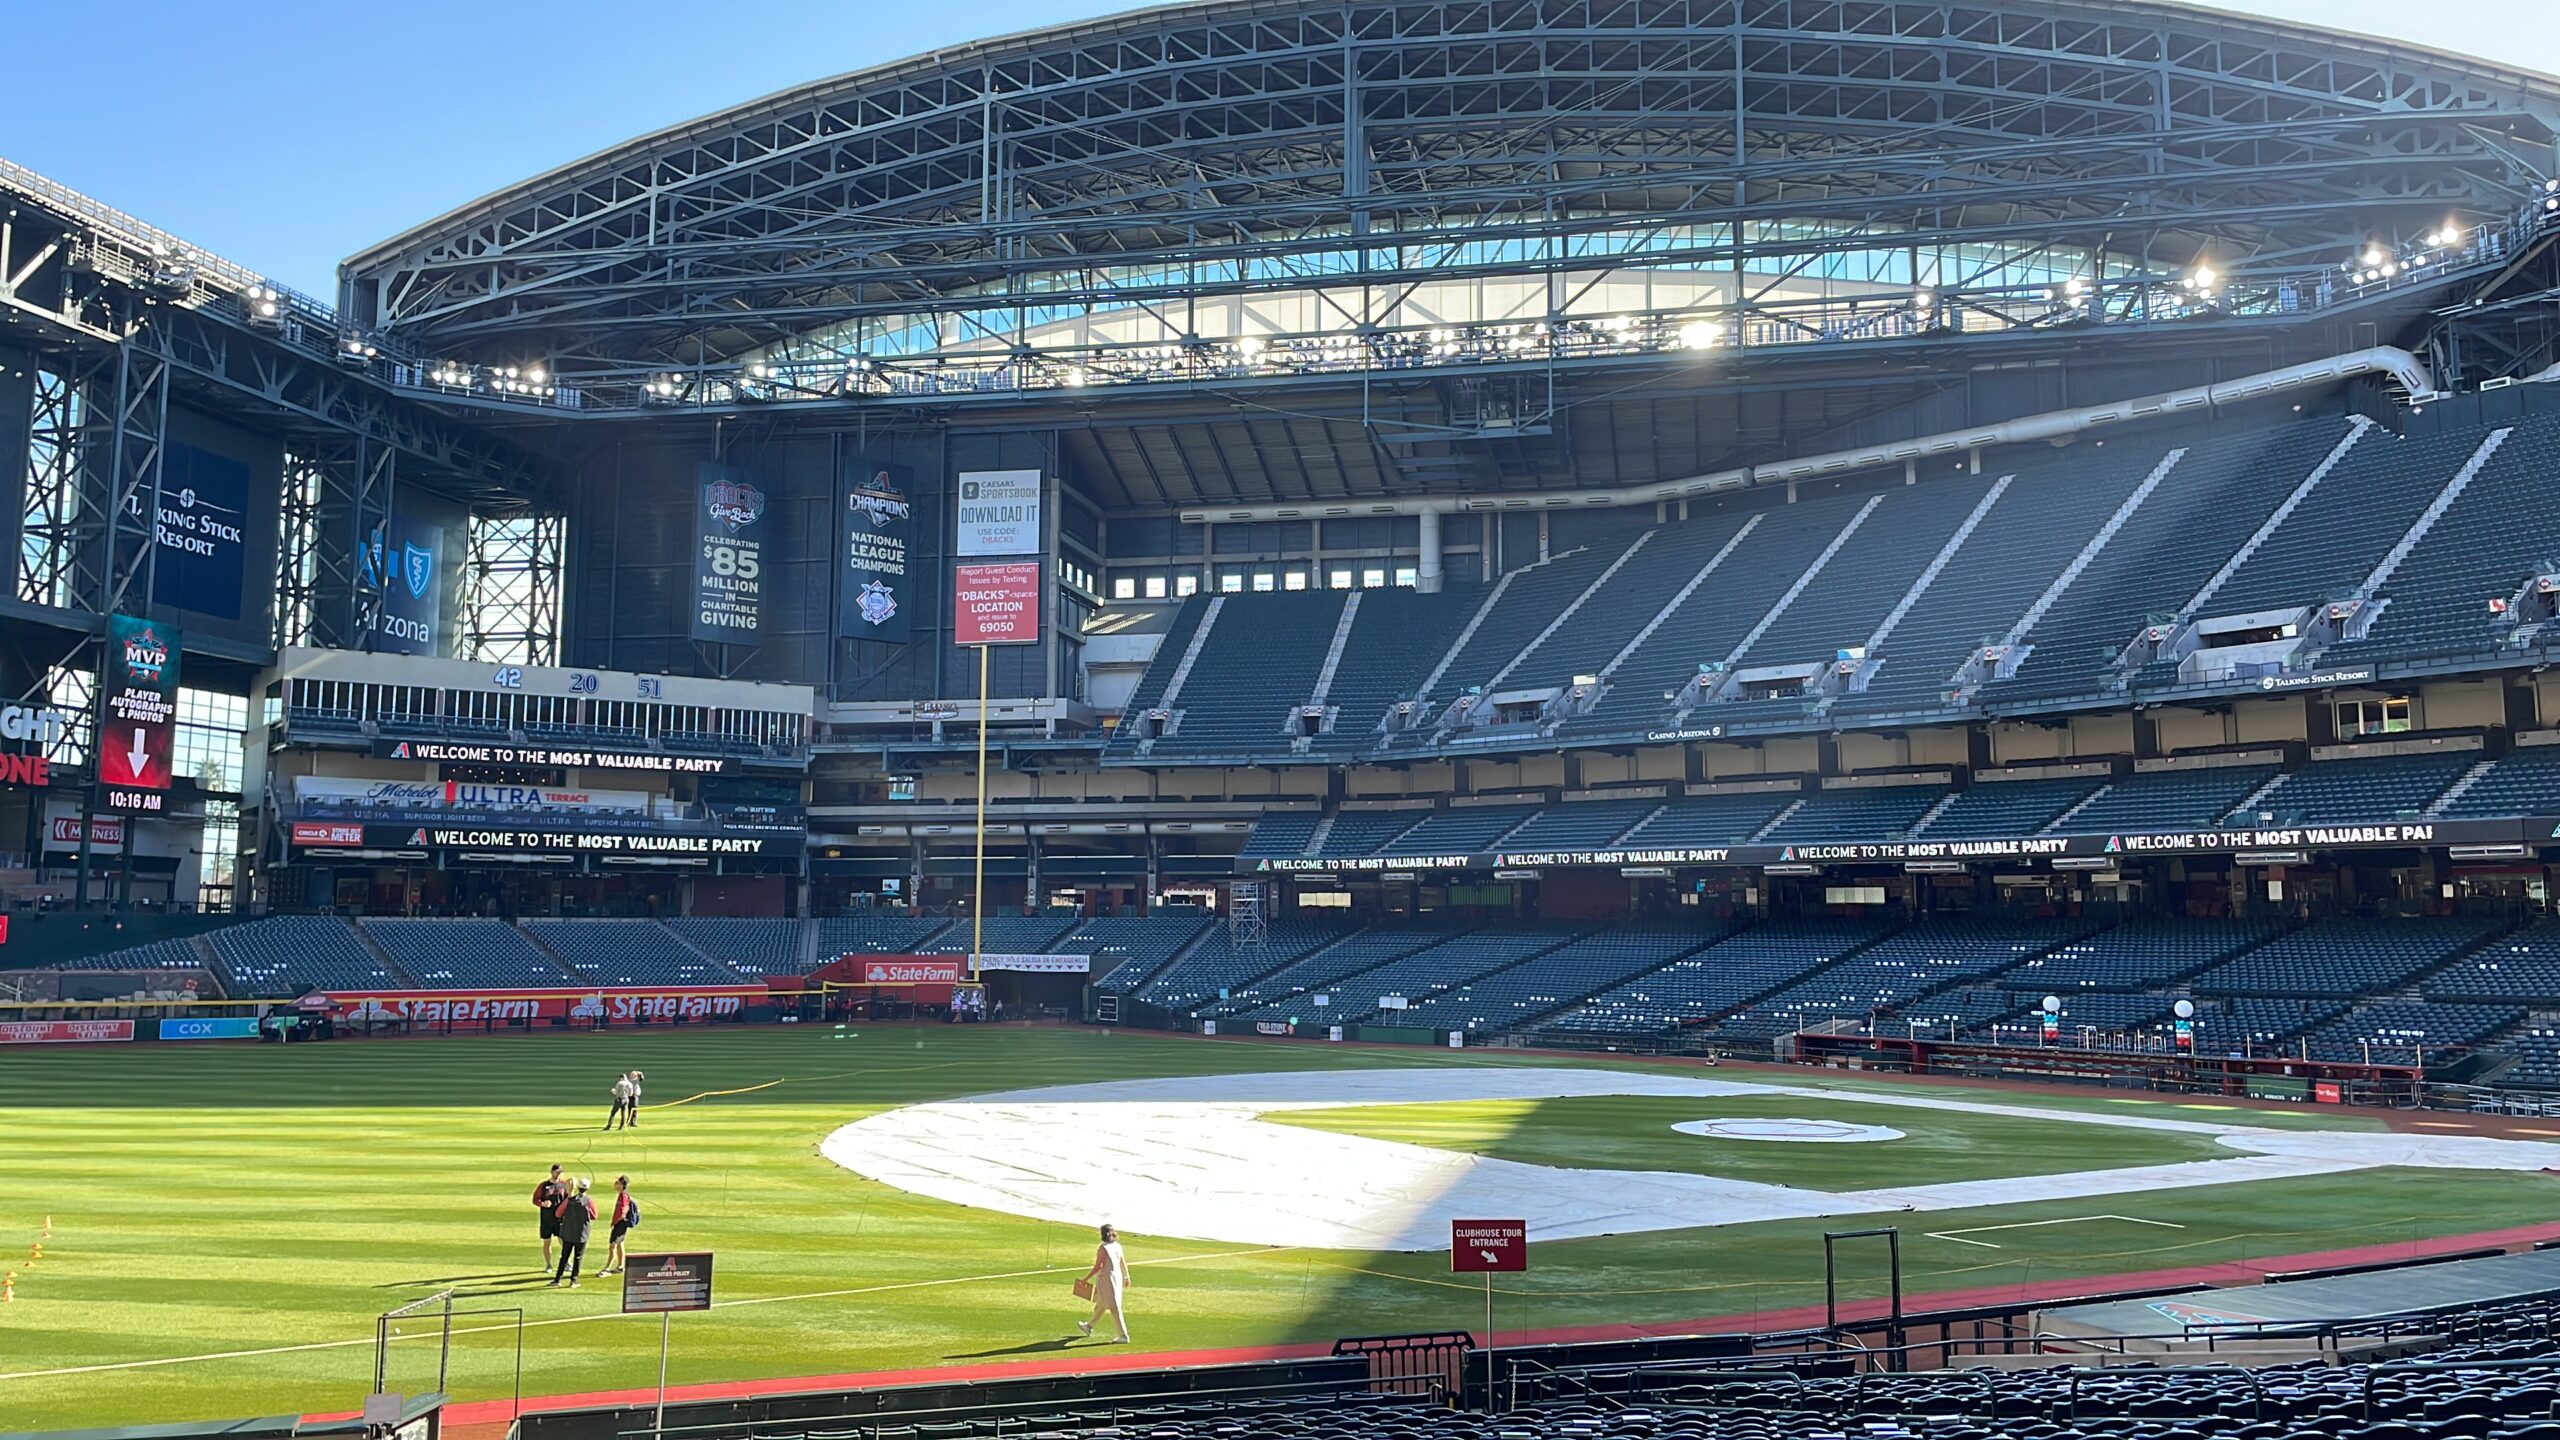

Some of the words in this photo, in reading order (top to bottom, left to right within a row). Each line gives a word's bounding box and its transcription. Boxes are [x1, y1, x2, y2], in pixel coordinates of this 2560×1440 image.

[981, 488, 1037, 500] SPORTSBOOK
[710, 503, 732, 518] Give
[730, 507, 756, 523] Back
[850, 493, 909, 519] CHAMPIONS
[961, 506, 1022, 523] DOWNLOAD
[1026, 505, 1037, 521] IT
[200, 515, 240, 543] STICK
[156, 525, 215, 556] RESORT
[704, 535, 760, 549] CELEBRATING
[852, 531, 905, 549] NATIONAL
[982, 536, 1014, 544] DBACKS
[851, 543, 905, 562] LEAGUE
[704, 545, 759, 579] $85
[851, 557, 905, 575] CHAMPIONS
[961, 568, 983, 576] Report
[985, 567, 1005, 575] Guest
[1007, 566, 1035, 574] Conduct
[702, 575, 758, 593] MILLION
[993, 576, 1000, 585] by
[1003, 575, 1027, 584] Texting
[725, 592, 736, 601] IN
[701, 600, 757, 614] CHARITABLE
[971, 602, 1023, 613] LOCATION
[701, 611, 757, 629] GIVING
[980, 622, 1014, 632] 69050
[126, 647, 166, 666] MVP
[494, 667, 522, 688] 42
[569, 674, 598, 693] 20
[2275, 678, 2309, 686] TALKING
[2311, 674, 2335, 683] STICK
[2336, 671, 2369, 681] RESORT
[125, 687, 161, 702] PLAYER
[638, 678, 662, 699] 51
[110, 696, 173, 714] AUTOGRAPHS
[118, 707, 125, 718] &
[127, 709, 164, 723] PHOTOS
[1648, 732, 1676, 740] CASINO
[1677, 729, 1711, 738] ARIZONA
[416, 744, 490, 761] WELCOME
[494, 749, 513, 762] TO
[518, 750, 545, 763] THE
[550, 752, 592, 766] MOST
[597, 754, 672, 770] VALUABLE
[676, 759, 723, 772] PARTY
[109, 792, 141, 809] 10:16
[144, 794, 161, 810] AM
[367, 782, 440, 798] Michelob
[460, 785, 542, 804] ULTRA
[545, 793, 588, 803] TERRACE
[404, 810, 441, 820] SUPERIOR
[443, 813, 465, 821] LIGHT
[540, 817, 571, 825] ULTRA
[331, 833, 360, 842] METER
[434, 830, 513, 846] WELCOME
[518, 833, 539, 847] TO
[543, 834, 573, 847] THE
[577, 834, 622, 849] MOST
[628, 836, 707, 851] VALUABLE
[712, 838, 762, 852] PARTY
[2125, 835, 2195, 849] WELCOME
[2198, 834, 2217, 848] TO
[2221, 832, 2251, 846] THE
[2255, 830, 2301, 845] MOST
[2305, 827, 2397, 843] VALUABLE
[1507, 853, 1554, 865] WELCOME
[1556, 853, 1569, 864] TO
[1572, 853, 1592, 864] THE
[1594, 852, 1624, 863] MOST
[1627, 850, 1686, 862] VALUABLE
[1689, 849, 1728, 861] PARTY
[1798, 846, 1858, 859] WELCOME
[1860, 845, 1877, 858] TO
[1880, 844, 1905, 857] THE
[1908, 844, 1946, 856] MOST
[1950, 841, 2019, 855] VALUABLE
[2022, 839, 2068, 853] PARTY
[1273, 859, 1323, 870] WELCOME
[1326, 859, 1339, 869] TO
[1341, 859, 1357, 869] THE
[1359, 858, 1383, 869] MOST
[1386, 857, 1434, 868] VALUABLE
[1436, 856, 1468, 867] PARTY
[0, 1024, 53, 1034] DISCOUNT
[67, 1023, 118, 1033] DISCOUNT
[179, 1024, 212, 1034] COX
[1456, 1228, 1500, 1237] CLUBHOUSE
[1502, 1228, 1522, 1237] TOUR
[1470, 1238, 1508, 1247] ENTRANCE
